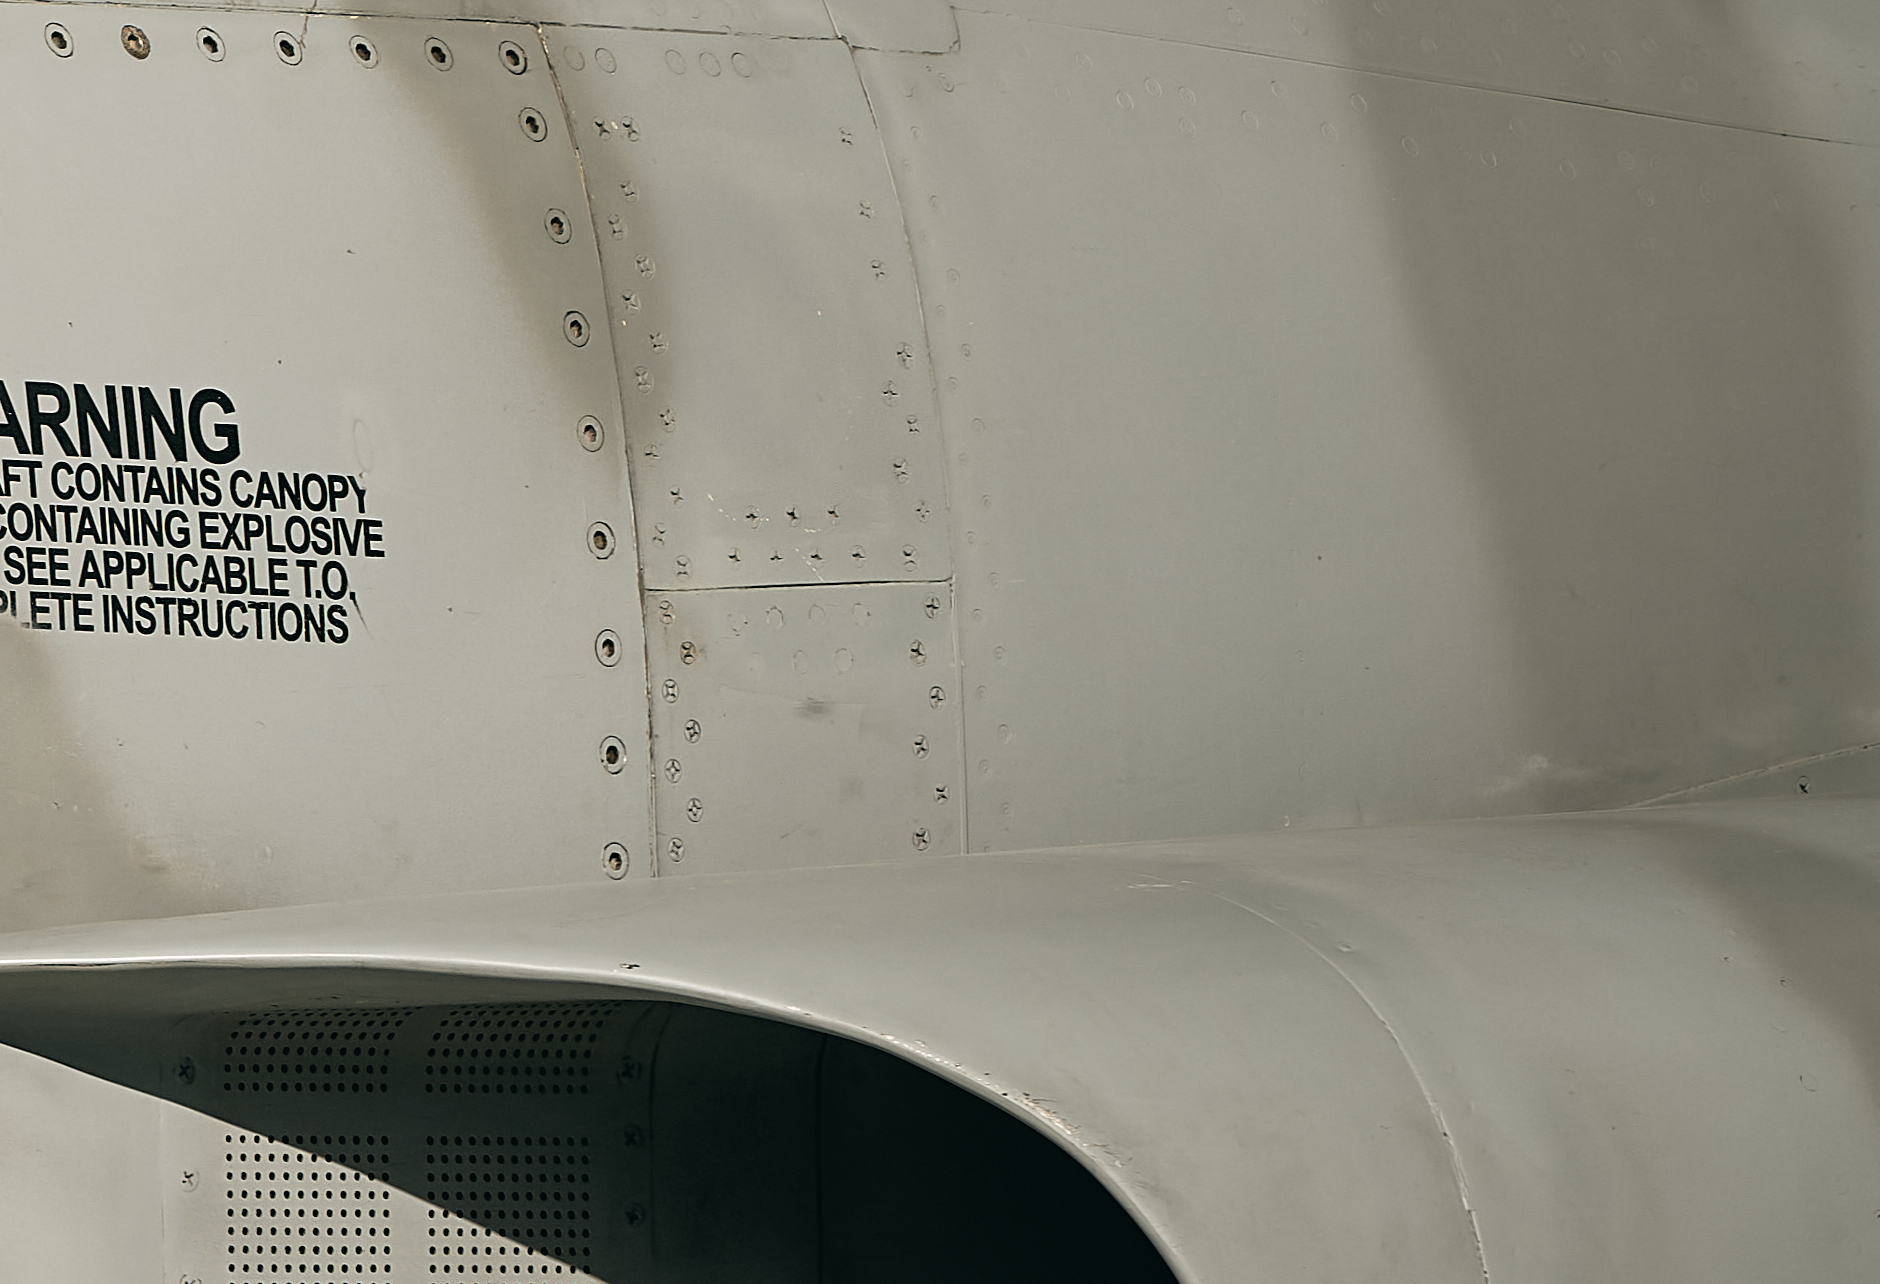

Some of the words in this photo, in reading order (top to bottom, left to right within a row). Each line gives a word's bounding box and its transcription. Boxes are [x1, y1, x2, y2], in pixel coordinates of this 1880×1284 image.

[50, 463, 223, 509] CONTAINS
[228, 468, 368, 514] CANOPY
[200, 513, 385, 558] EXPLOSIVE
[4, 547, 71, 587] SEE
[77, 551, 290, 598] APPLICABLE
[102, 593, 350, 646] INSTRUCTIONS
